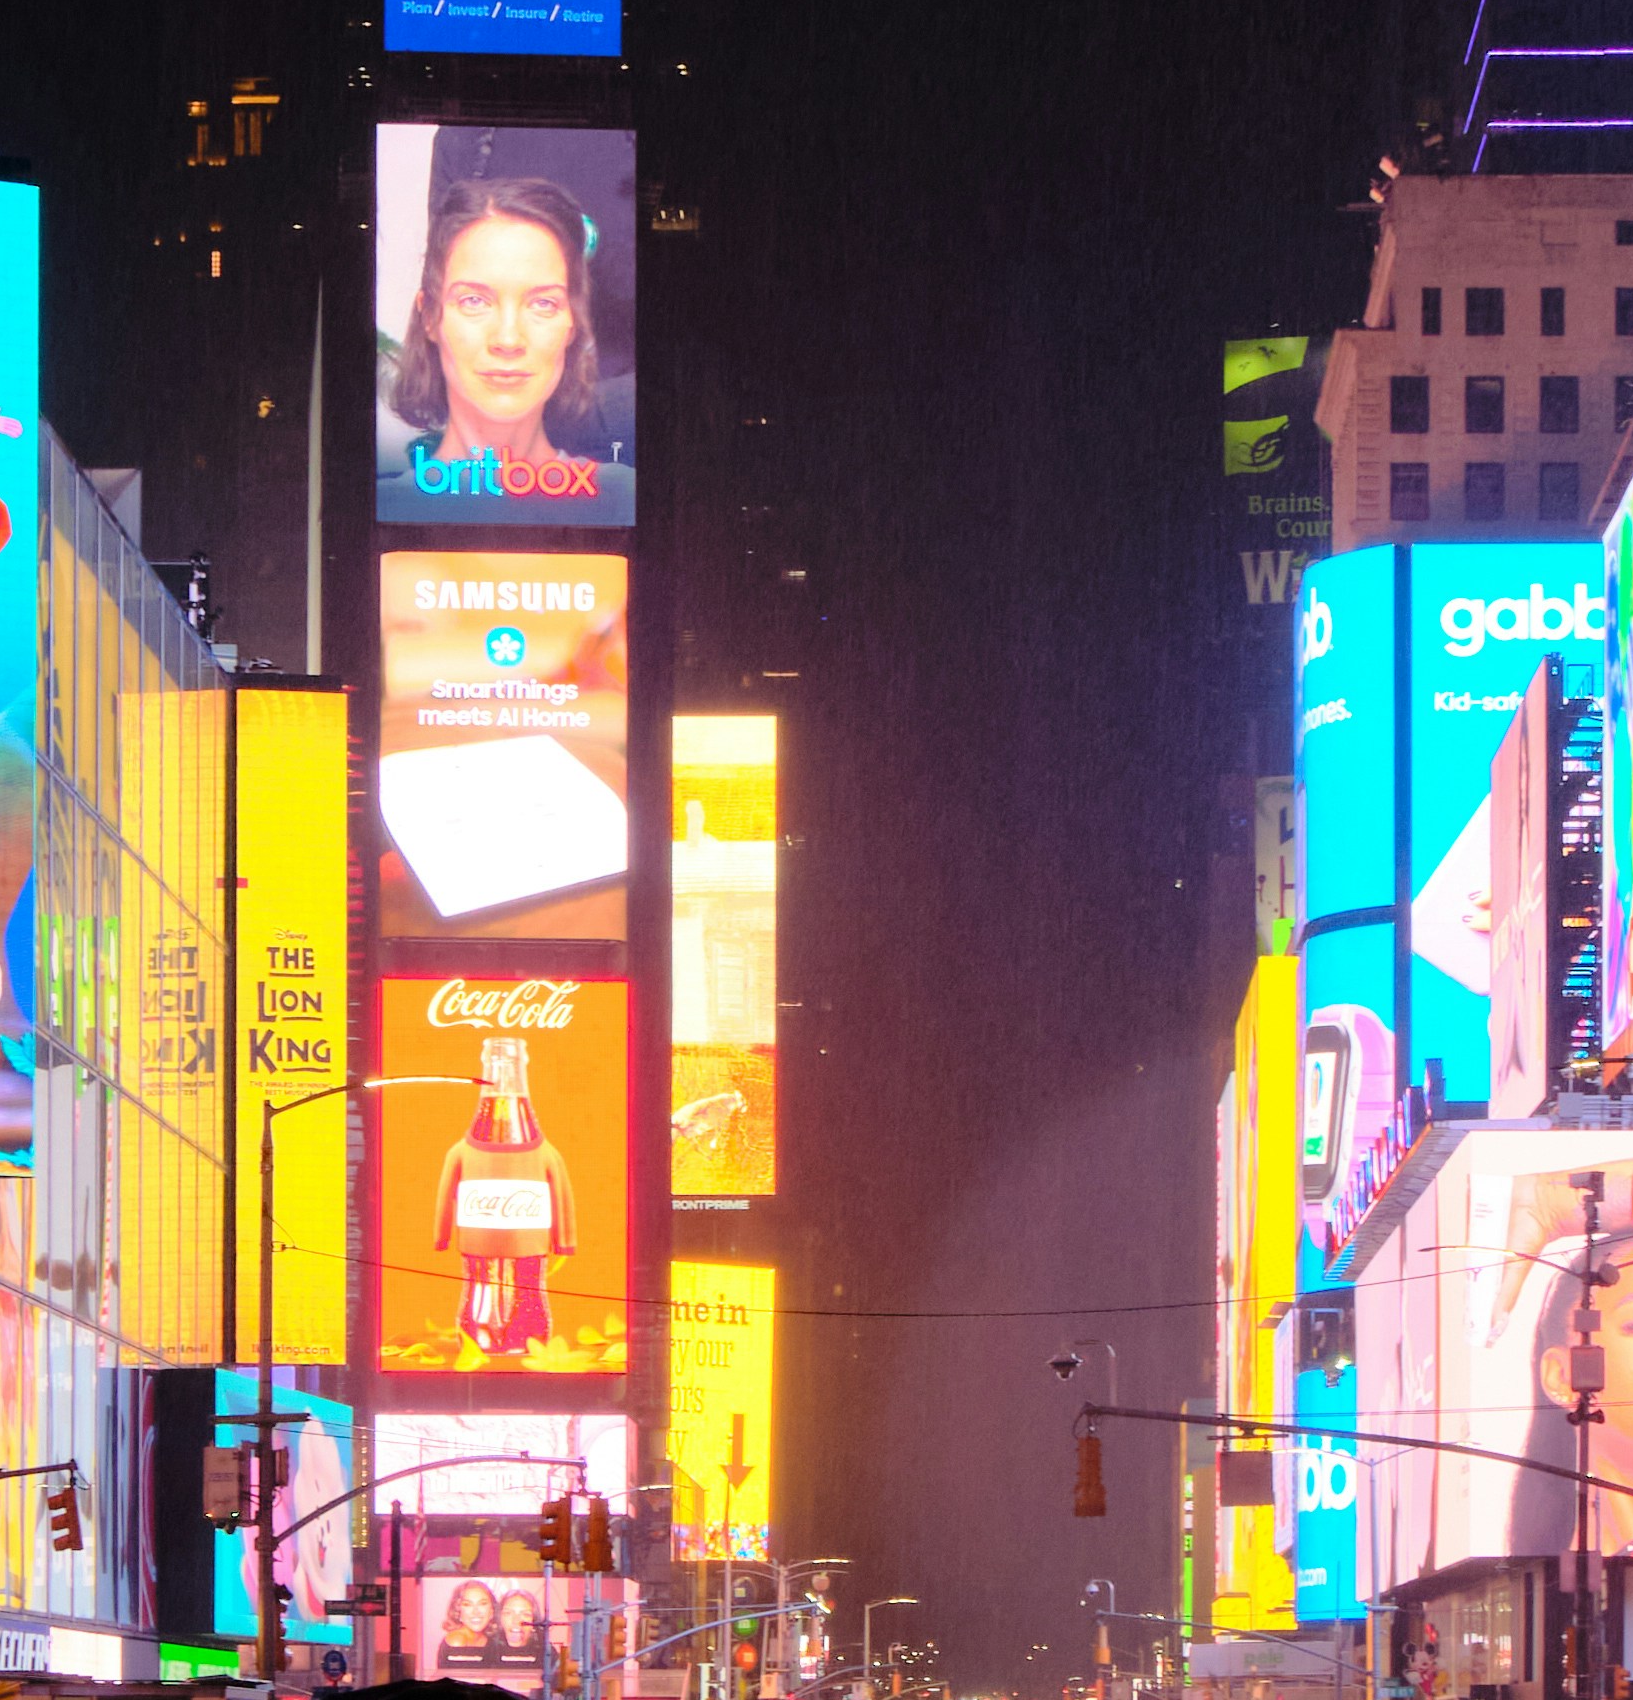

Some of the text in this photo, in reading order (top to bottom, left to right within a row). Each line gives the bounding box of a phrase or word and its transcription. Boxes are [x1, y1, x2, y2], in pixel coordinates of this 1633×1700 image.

[403, 1, 604, 23] Plan Invest Insure Retire
[416, 445, 598, 496] britbox
[1248, 493, 1331, 515] Brains.
[415, 580, 595, 611] SAMSUNG
[1440, 583, 1605, 657] gabb
[432, 678, 578, 705] SmartThings
[1434, 691, 1524, 711] Kid-saf
[418, 707, 590, 727] meets AI Home
[267, 946, 315, 970] THE
[257, 981, 322, 1022] LION
[427, 978, 580, 1029] Coca-Cola
[249, 1028, 331, 1074] KING
[464, 1189, 542, 1218] Coca-Cola
[717, 1294, 749, 1326] in
